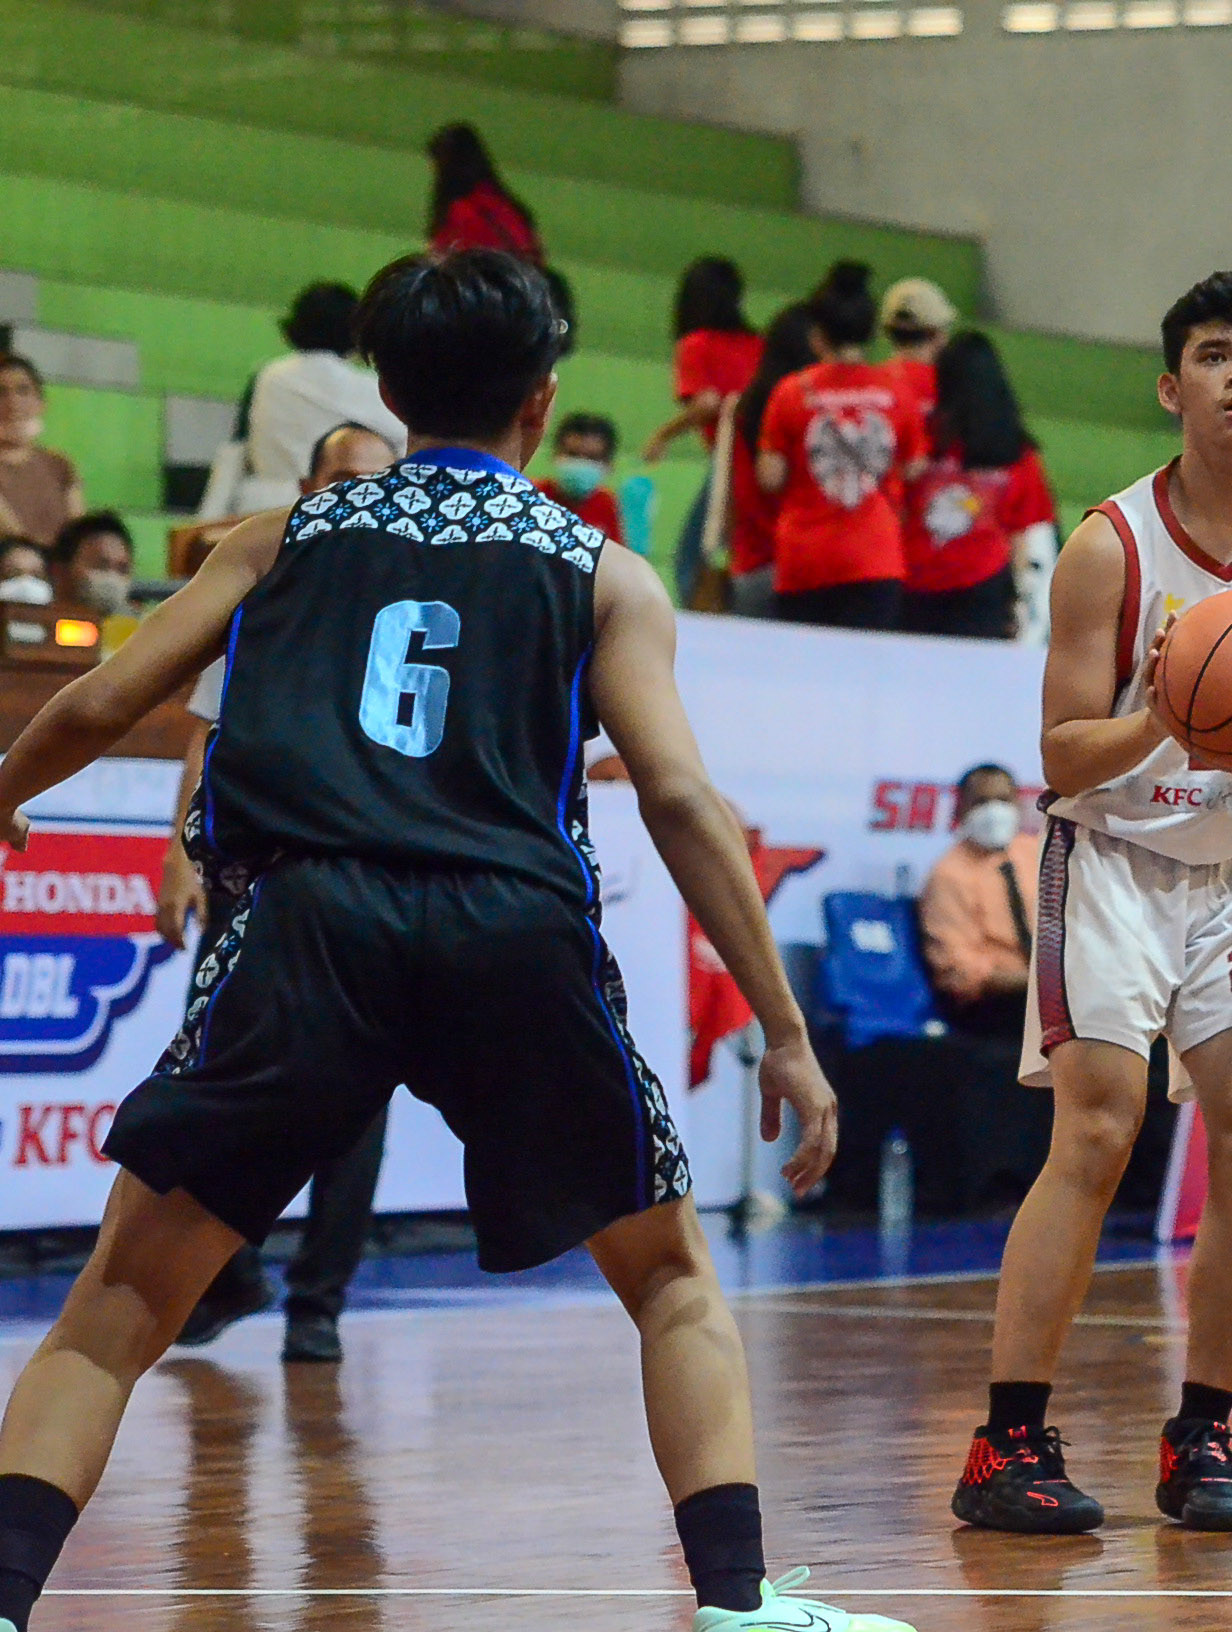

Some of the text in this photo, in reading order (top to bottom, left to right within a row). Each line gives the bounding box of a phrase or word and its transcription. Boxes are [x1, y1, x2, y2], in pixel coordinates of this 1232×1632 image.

[359, 600, 461, 758] 6
[1150, 784, 1203, 807] KFC
[4, 869, 158, 916] HONDA
[1, 952, 80, 1019] DBL
